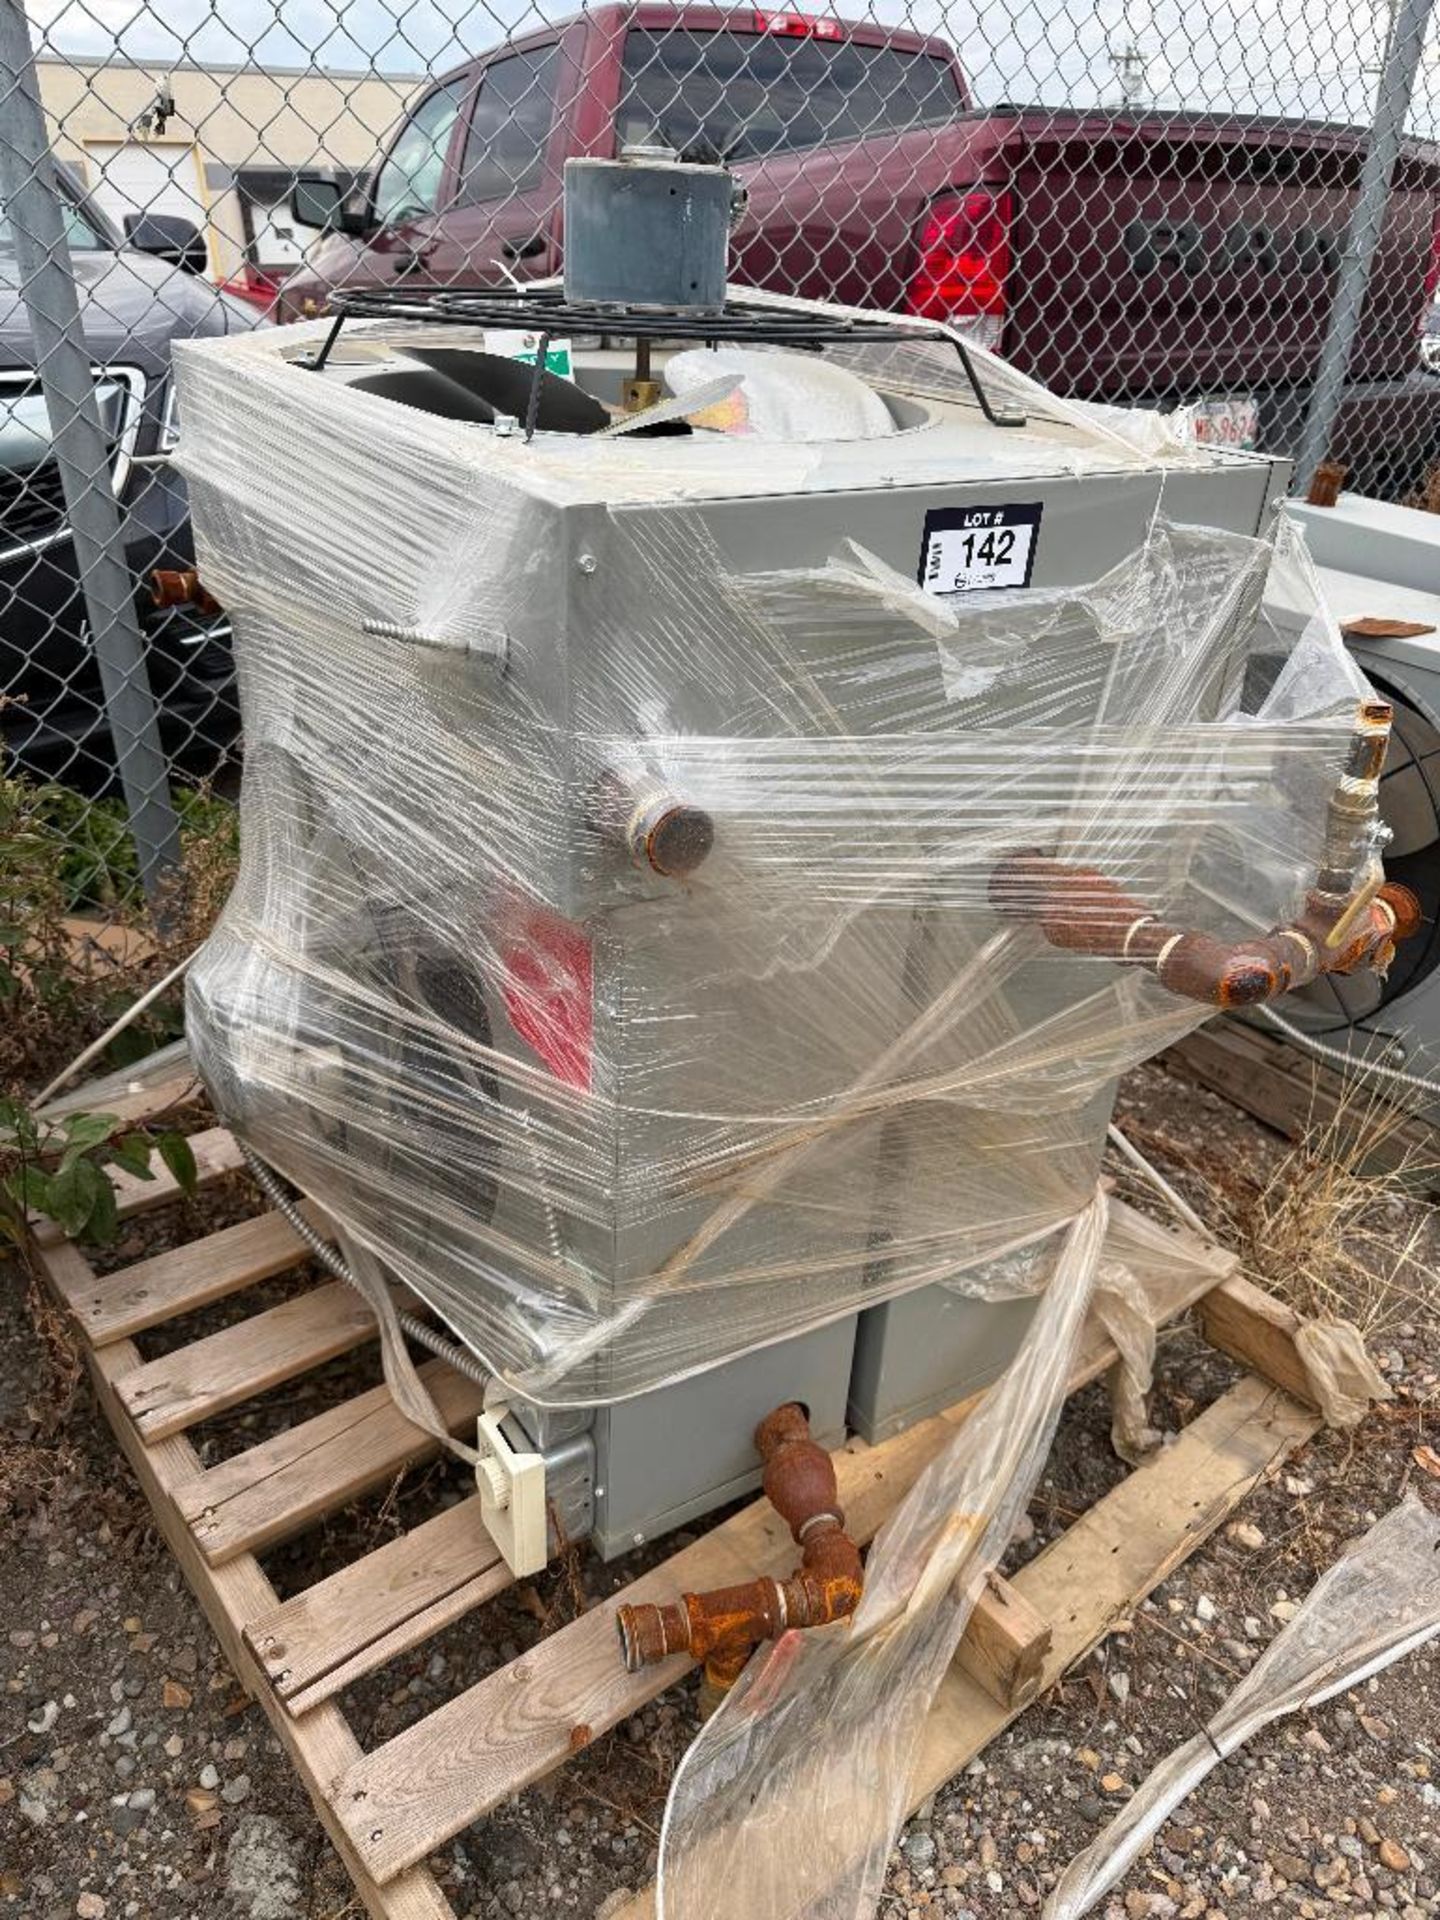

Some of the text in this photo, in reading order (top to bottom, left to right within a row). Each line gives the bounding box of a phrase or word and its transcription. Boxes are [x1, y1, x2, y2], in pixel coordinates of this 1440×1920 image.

[963, 510, 1005, 527] LOT #
[962, 529, 1015, 568] 142
